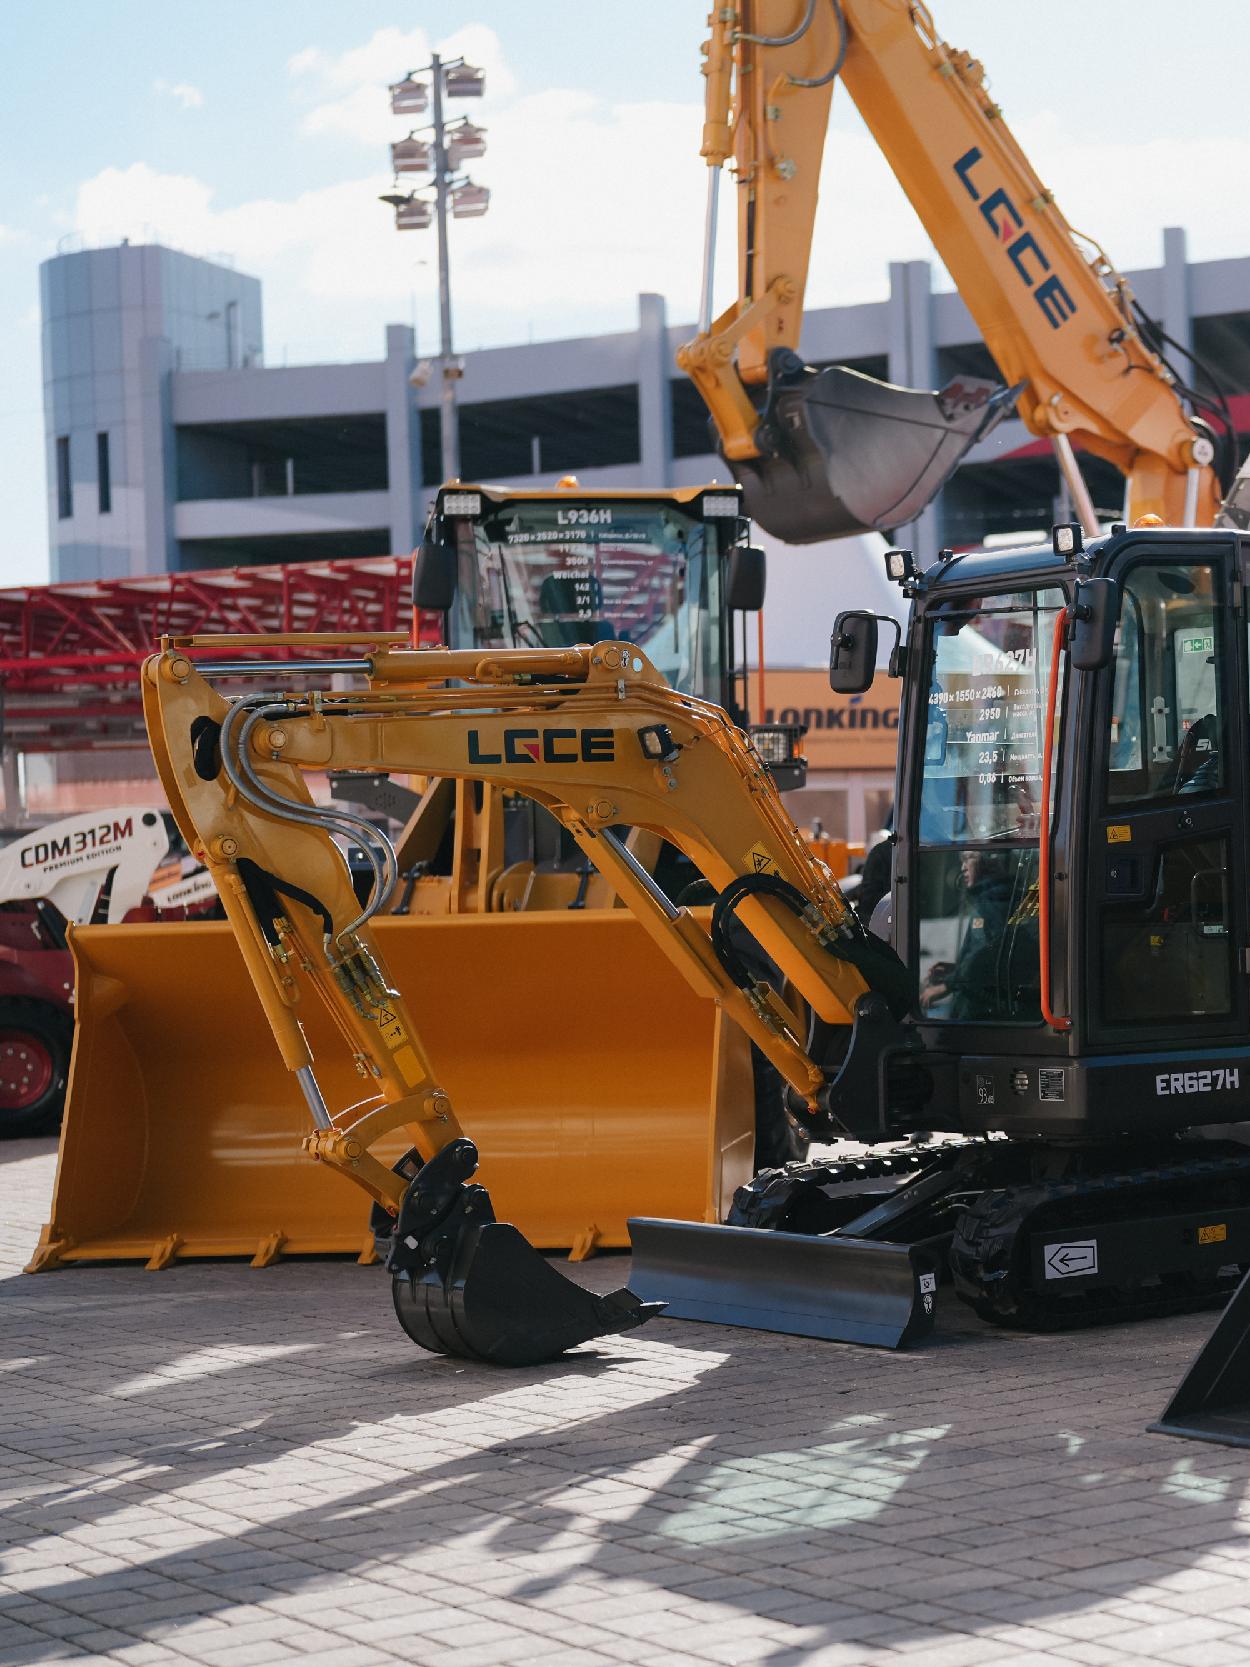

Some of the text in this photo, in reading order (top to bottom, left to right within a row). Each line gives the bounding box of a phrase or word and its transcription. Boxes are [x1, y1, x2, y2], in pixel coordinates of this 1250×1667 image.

[557, 509, 612, 525] L936H
[979, 708, 1000, 721] 2950
[966, 731, 999, 743] Yanmar
[468, 728, 616, 764] LGCE
[979, 751, 998, 764] 23,5
[43, 844, 123, 874] PREMIUM EDITION
[1156, 1068, 1239, 1096] ER627H
